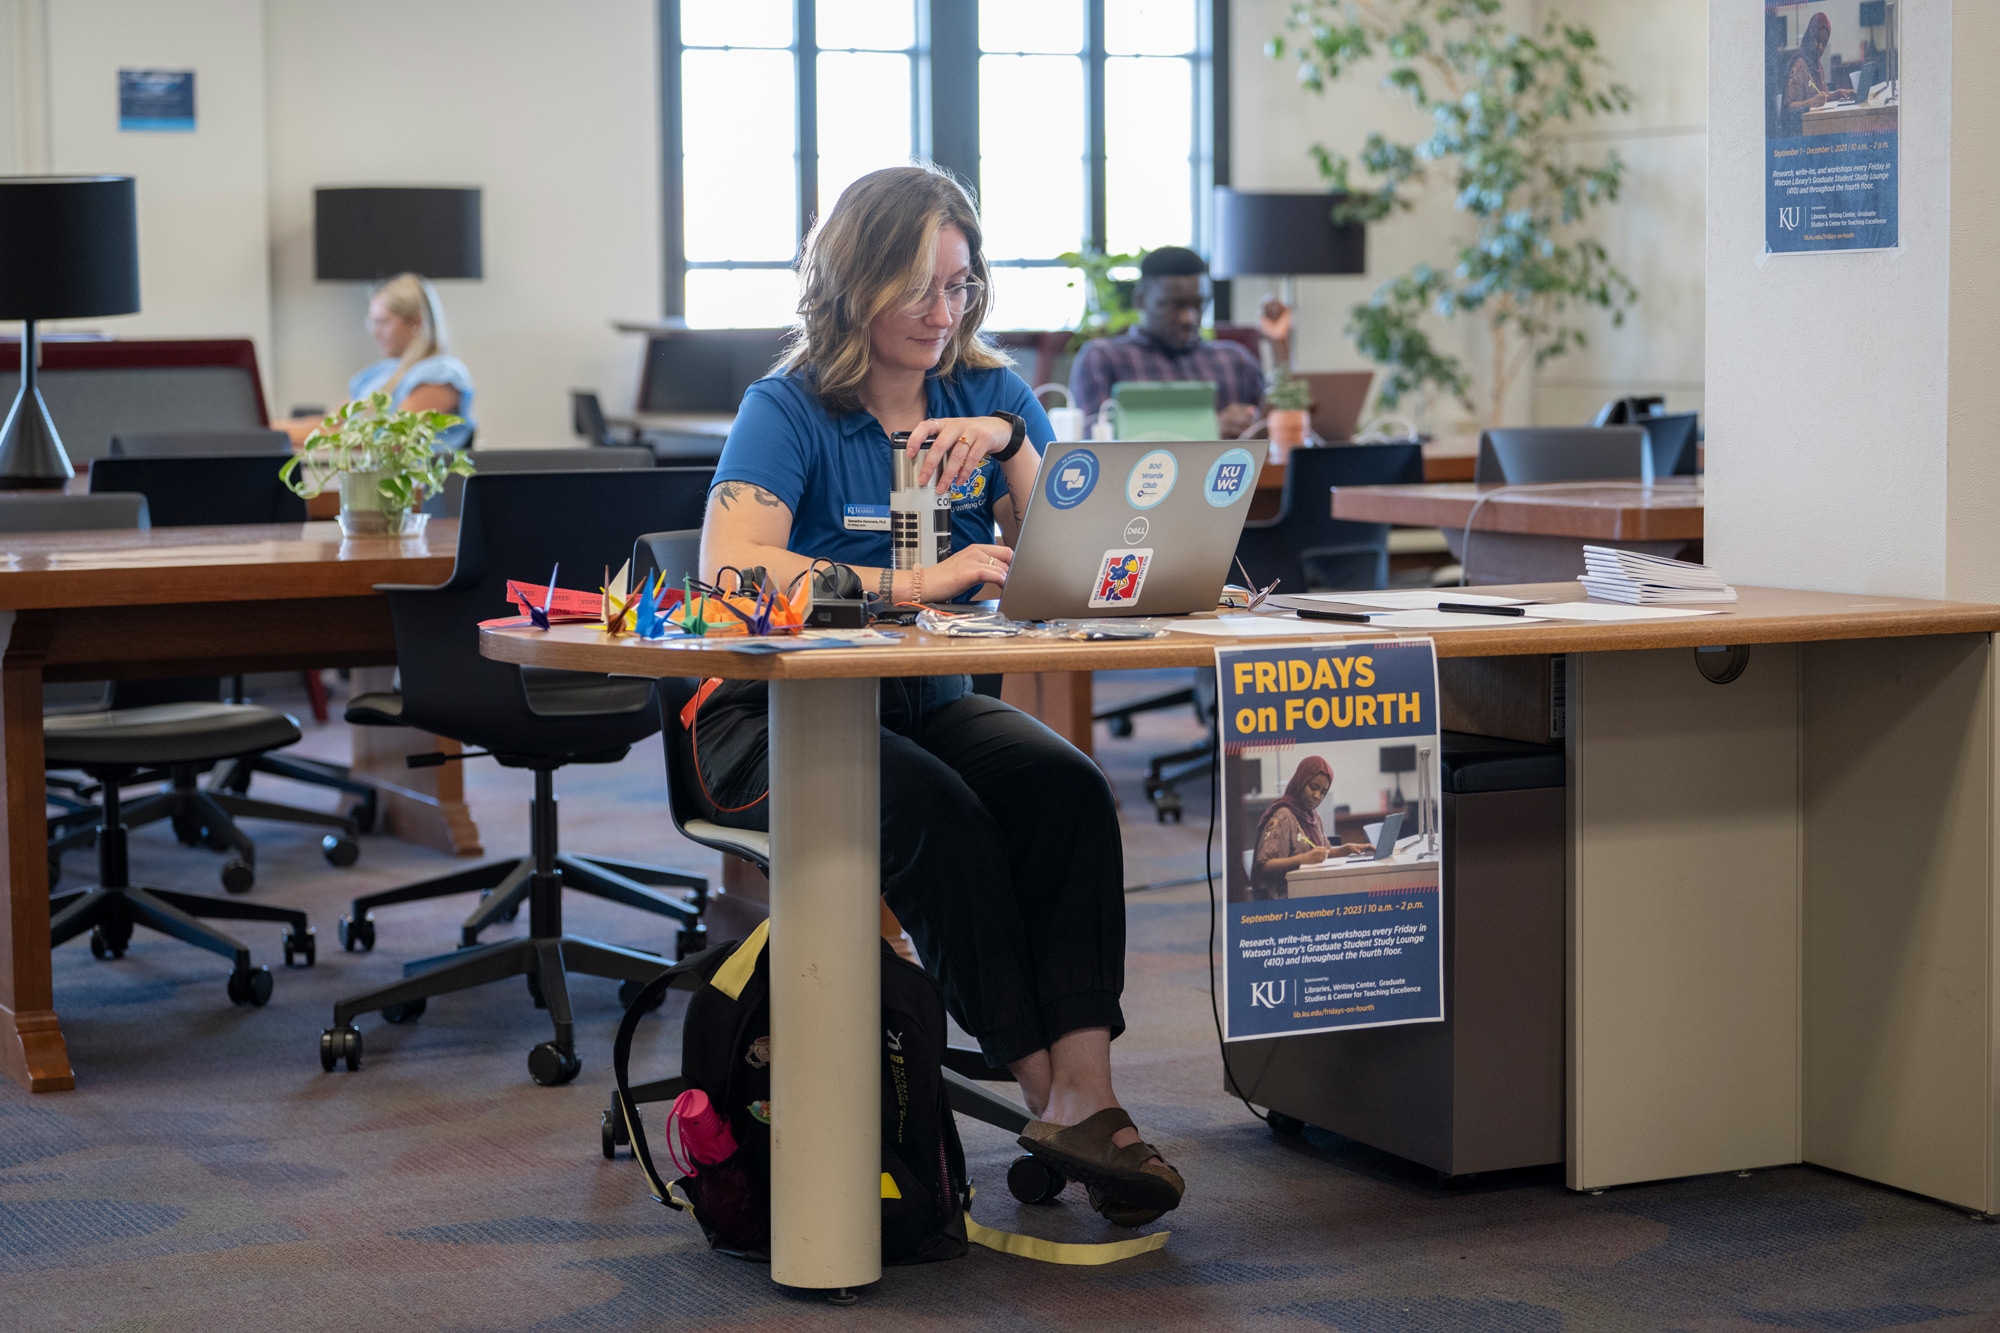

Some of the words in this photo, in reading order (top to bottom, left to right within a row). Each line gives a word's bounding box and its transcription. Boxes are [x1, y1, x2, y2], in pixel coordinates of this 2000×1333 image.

[1774, 149, 1799, 157] September
[1806, 146, 1830, 154] December
[1835, 144, 1847, 152] 2023
[1773, 169, 1794, 178] Research,
[1854, 173, 1869, 181] Study
[1809, 185, 1835, 194] throughout
[1779, 207, 1800, 230] KU
[1221, 466, 1241, 478] KU
[1218, 479, 1238, 490] WC
[848, 506, 858, 515] KU
[955, 502, 978, 511] Writing
[1234, 656, 1375, 694] FRIDAYS
[1236, 707, 1277, 734] on
[1285, 692, 1420, 731] FOURTH
[1241, 912, 1283, 924] September
[1285, 912, 1288, 920] 1
[1296, 908, 1334, 919] December
[1336, 908, 1341, 916] 1,
[1343, 905, 1362, 915] 2023
[1368, 904, 1377, 912] 10
[1401, 902, 1406, 910] 2
[1407, 901, 1424, 910] p.m.
[1239, 937, 1276, 948] Research,
[1278, 934, 1313, 944] write-ins,
[1315, 932, 1330, 941] and
[1331, 929, 1370, 940] workshops
[1372, 928, 1393, 936] every
[1394, 925, 1417, 934] Friday
[1419, 924, 1426, 932] in
[1242, 950, 1271, 958] Watson
[1307, 942, 1341, 953] Graduate
[1343, 939, 1372, 949] Student
[1373, 937, 1395, 946] Study
[1396, 935, 1424, 944] Lounge
[1264, 958, 1284, 968] (410)
[1285, 956, 1300, 965] and
[1302, 952, 1344, 963] throughout
[1345, 951, 1358, 959] the
[1359, 948, 1382, 958] fourth
[1383, 947, 1402, 956] floor.
[1379, 978, 1406, 986] Graduate
[1250, 979, 1287, 1008] KU
[1304, 995, 1326, 1003] Studies
[1390, 986, 1421, 994] Excellence
[1293, 1004, 1374, 1018] lib.ku.edu/fridays-on-fourth
